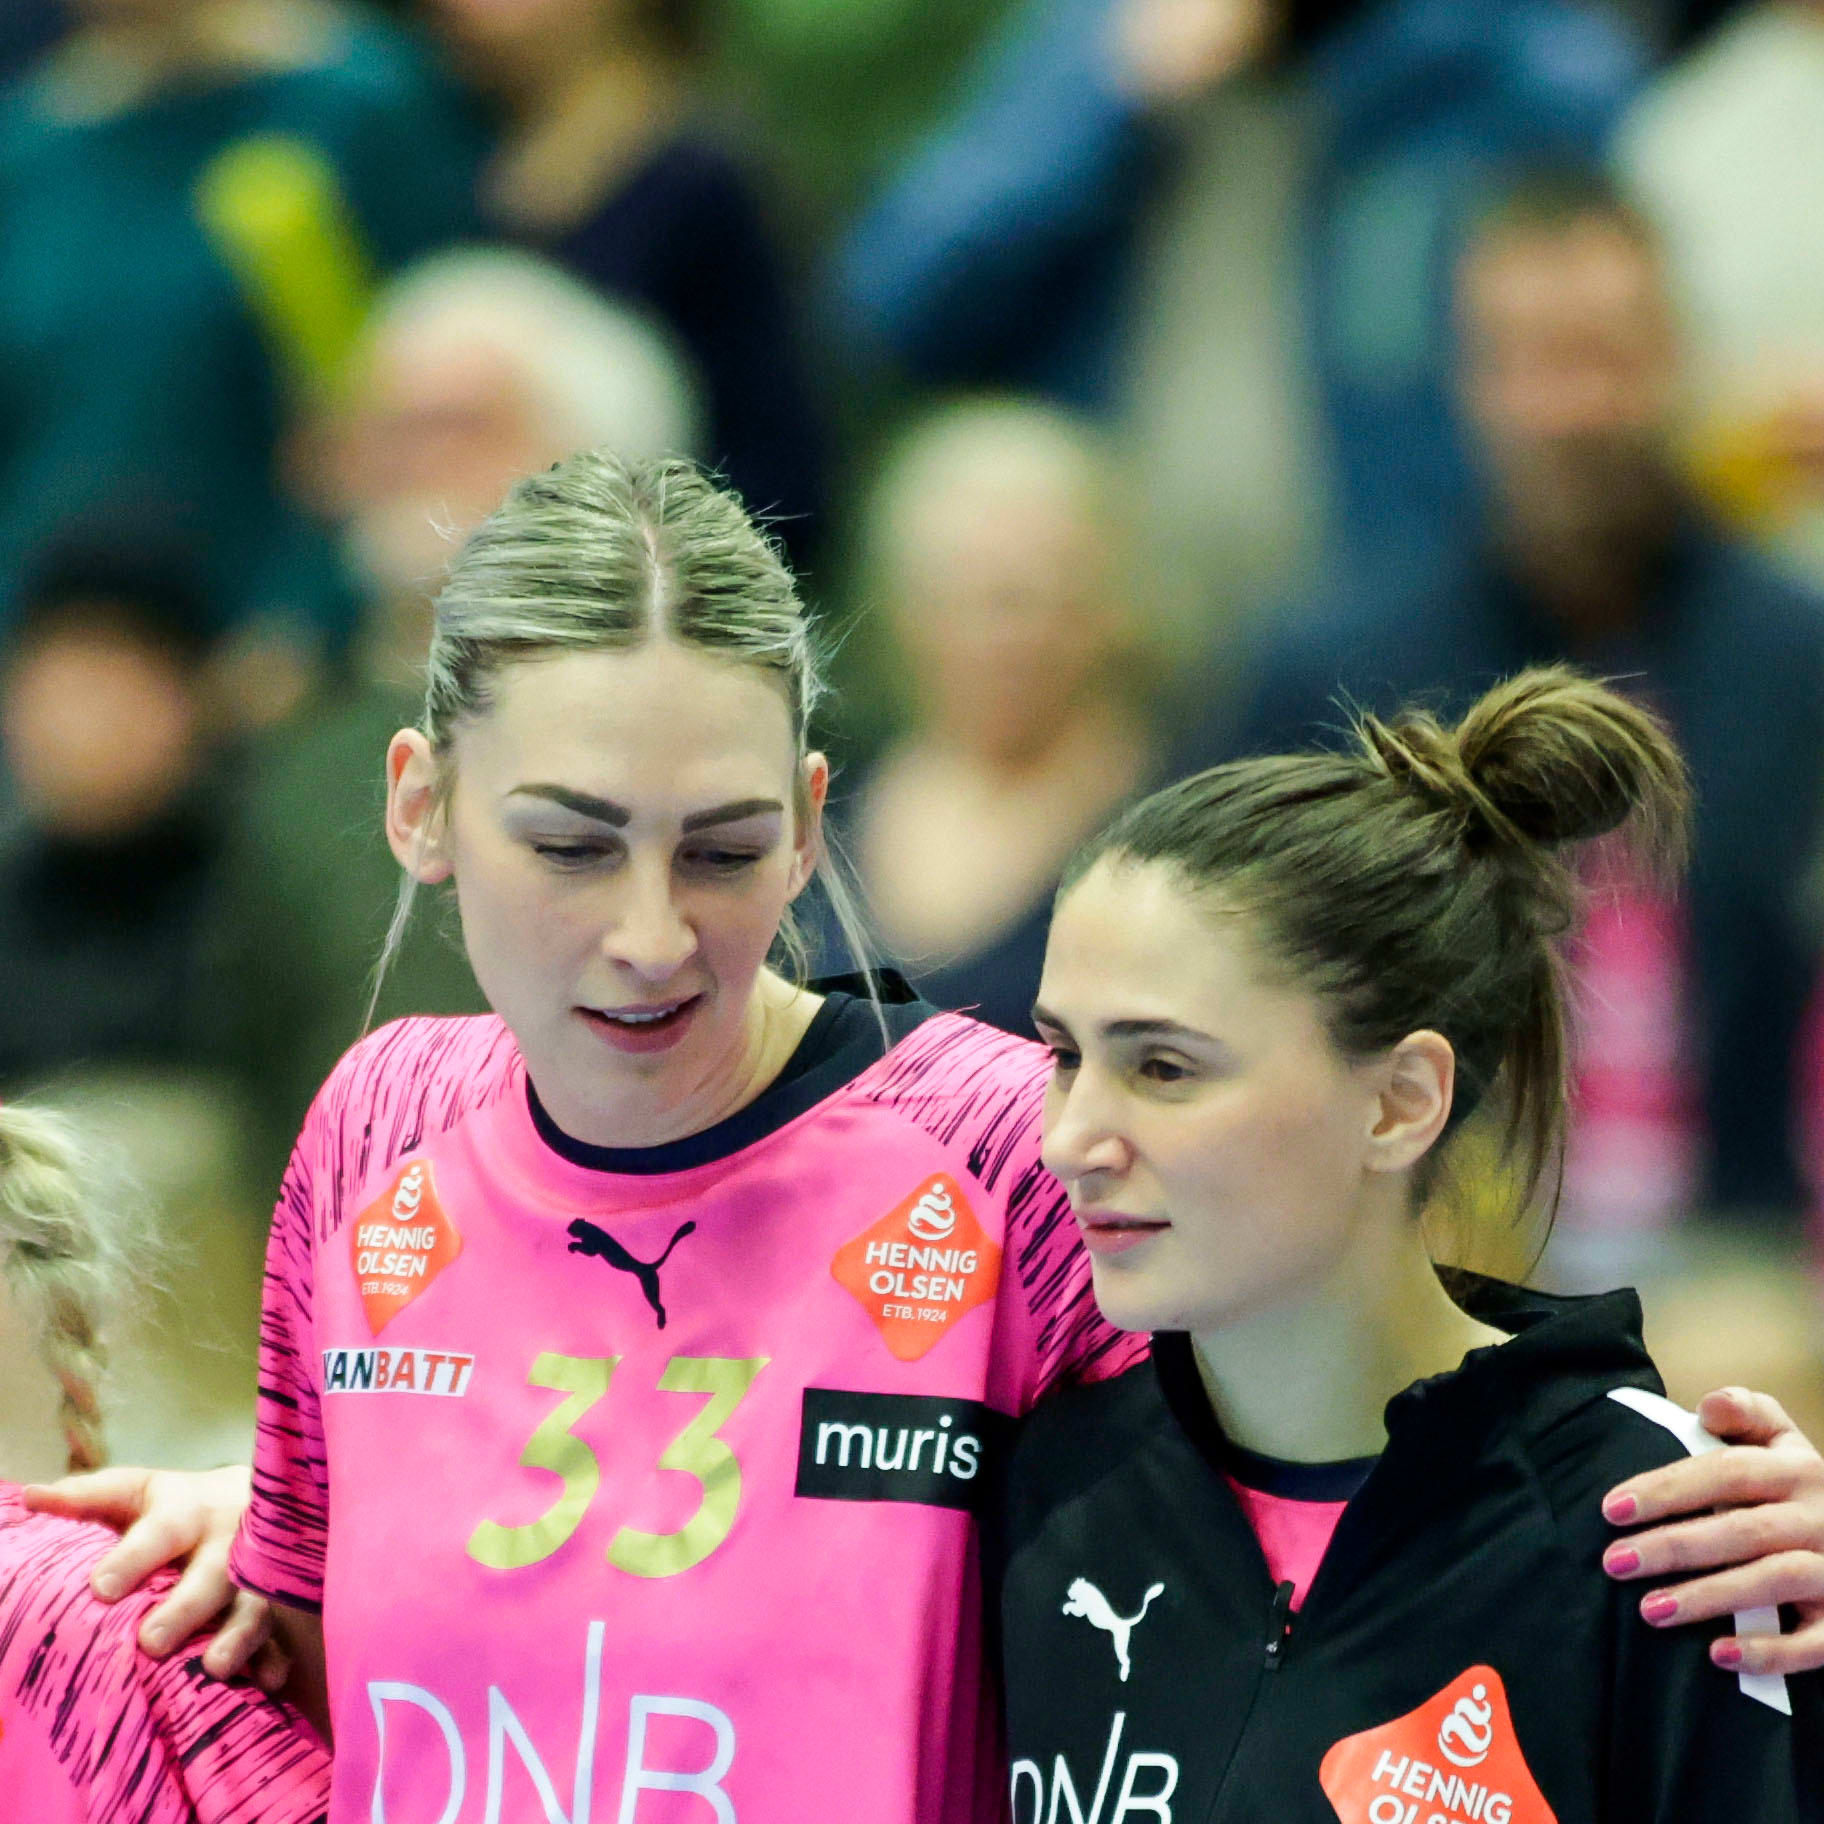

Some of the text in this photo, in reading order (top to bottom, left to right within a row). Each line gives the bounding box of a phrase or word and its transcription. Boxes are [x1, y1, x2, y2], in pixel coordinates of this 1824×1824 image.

[357, 1225, 436, 1251] HENNIG
[357, 1251, 428, 1277] OLSEN
[864, 1241, 979, 1275] HENNIG
[869, 1269, 966, 1302] OLSEN
[814, 1414, 983, 1481] muris
[466, 1351, 771, 1578] 33
